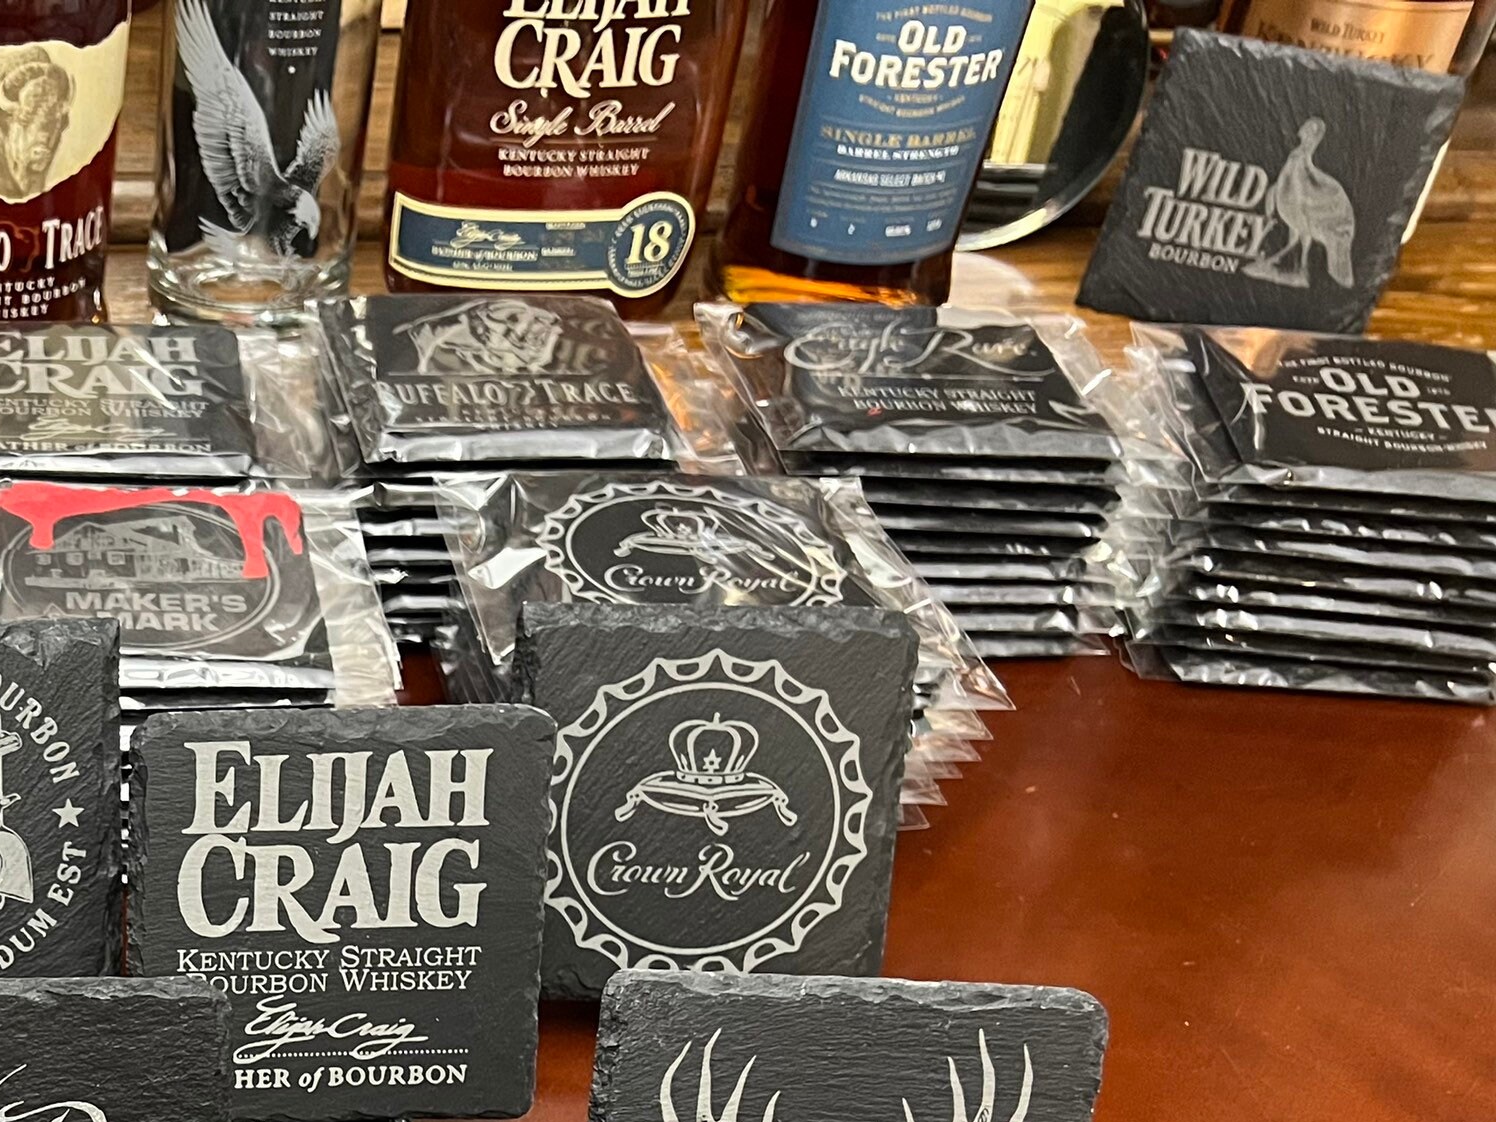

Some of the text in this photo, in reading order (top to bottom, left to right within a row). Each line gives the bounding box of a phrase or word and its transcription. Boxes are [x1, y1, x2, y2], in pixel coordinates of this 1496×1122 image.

[269, 10, 324, 21] STRAIGHT
[1310, 17, 1341, 38] WILD
[268, 28, 322, 40] BOURBON
[898, 20, 967, 54] OLD
[267, 46, 318, 57] WHISKEY
[494, 19, 682, 98] CRAIG
[829, 38, 1003, 89] FORESTER
[490, 99, 676, 148] Single Barrel
[820, 125, 977, 149] SINGLE BARREL
[498, 147, 650, 163] KENTUCKY STRAIGHT
[503, 163, 640, 178] BOURBON WHISKEY
[1176, 147, 1270, 209] WILD
[1137, 186, 1278, 258] TURKEY
[42, 205, 104, 270] TRACE
[627, 220, 673, 264] 18
[1149, 243, 1241, 274] BOURBON
[21, 277, 87, 305] BOURBON
[883, 327, 1056, 376] Rare
[1332, 356, 1386, 369] BOTTLED
[532, 379, 639, 405] TRACE
[837, 385, 1036, 401] KENTUCKY STRAIGHT
[1318, 366, 1421, 400] OLD
[100, 404, 205, 419] WHISKEY
[854, 398, 1039, 414] BOURBON WHISKEY
[1317, 426, 1380, 447] STRAIGHT
[1368, 427, 1435, 440] KENTUCKY
[604, 563, 804, 595] Crown Royal
[66, 591, 248, 613] MAKER'S
[108, 611, 221, 633] MARK
[181, 740, 494, 844] ELIJAH
[47, 841, 88, 907] EST
[587, 841, 810, 900] Crown Royal
[177, 833, 488, 944] CRAIG
[177, 944, 482, 973] KENTUCKY STRAIGHT
[339, 968, 473, 993] WHISKEY
[328, 1013, 429, 1060] Craig
[298, 1063, 468, 1093] of BOURBON
